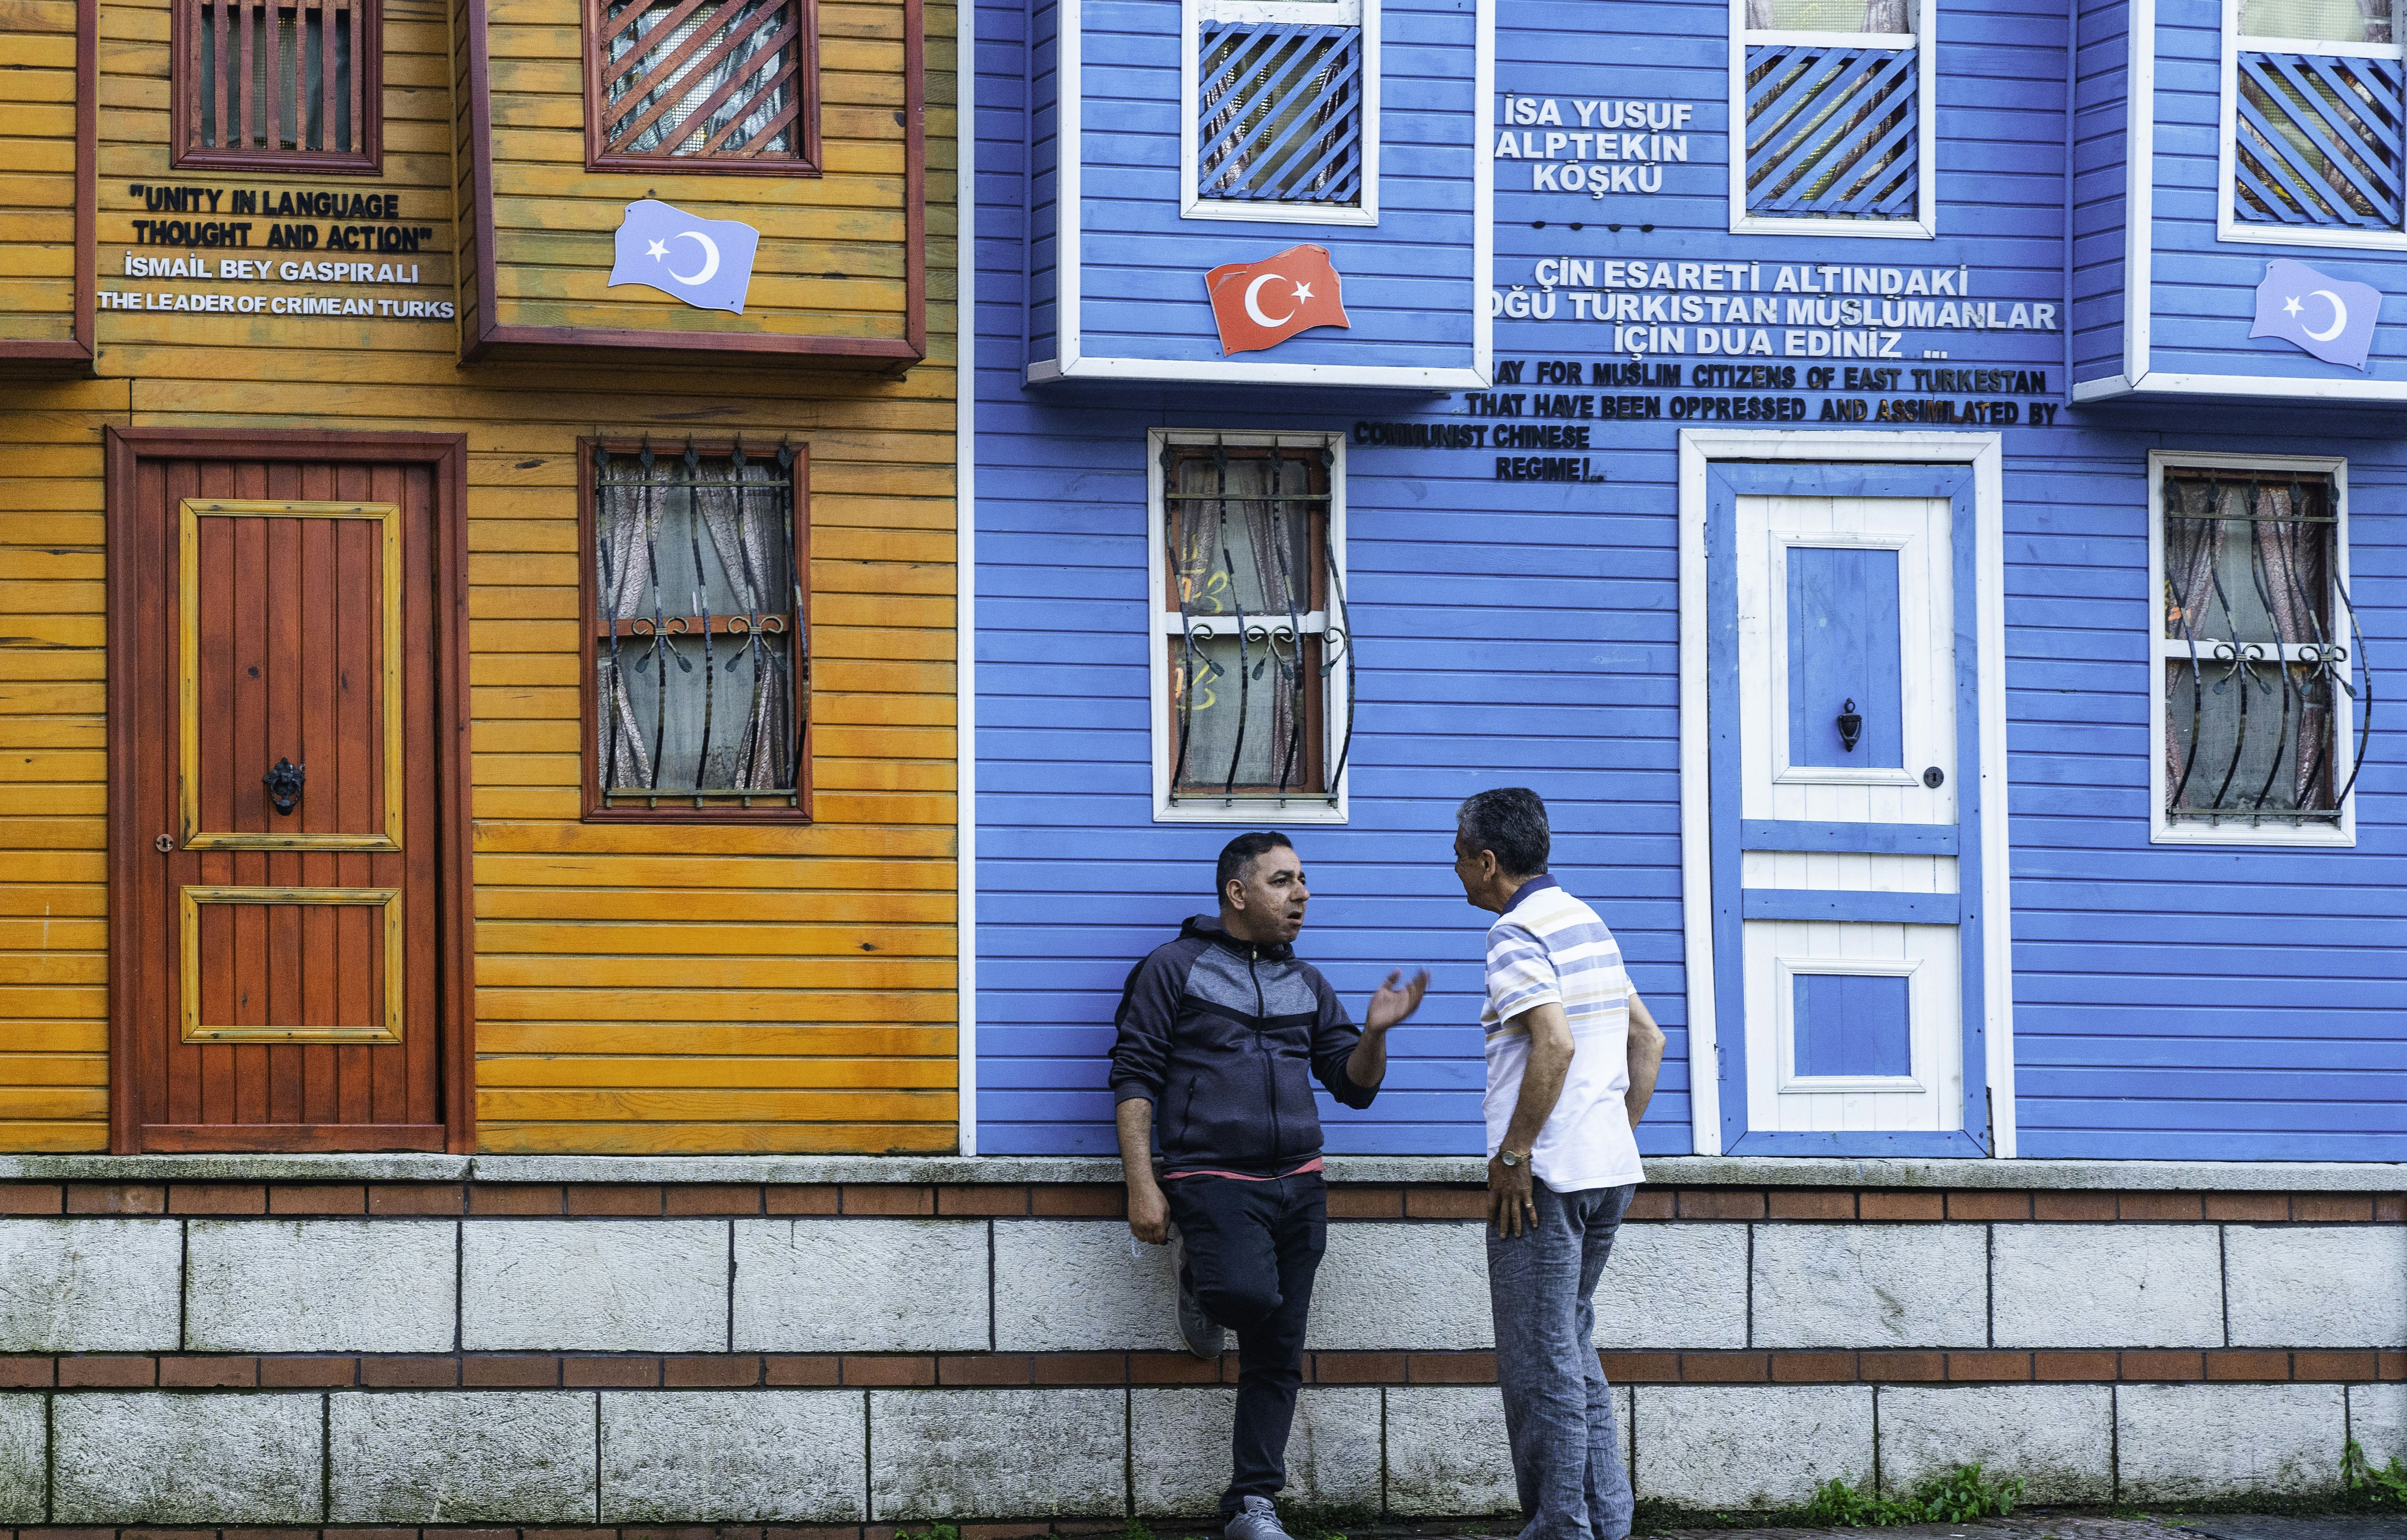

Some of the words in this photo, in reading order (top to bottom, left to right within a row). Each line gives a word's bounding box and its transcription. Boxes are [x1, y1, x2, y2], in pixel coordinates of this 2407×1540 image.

[1505, 94, 1563, 126] İSA
[1572, 100, 1692, 130] YUSUF
[1494, 129, 1687, 162] ALPTEKİN
[1533, 159, 1662, 199] KÖŞKÜ
[131, 184, 223, 212] "UNITY
[232, 190, 256, 213] IN
[263, 191, 399, 218] LANGUAGE
[133, 220, 252, 246] THOUGHT
[268, 224, 318, 248] AND
[328, 225, 433, 251] ACTION"
[125, 251, 212, 279] İSMAİL
[220, 260, 273, 279] BEY
[279, 261, 419, 283] GASPIRALI
[1535, 257, 1594, 293] ÇİN
[1604, 260, 1760, 291] ESARETİ
[1772, 264, 1968, 296] ALTINDAKİ
[97, 291, 142, 310] THE
[146, 293, 235, 312] LEADER
[237, 296, 267, 313] OF
[270, 297, 374, 316] CRIMEAN
[378, 299, 455, 318] TURKS
[1614, 321, 1684, 361] İÇİN
[1697, 327, 1773, 356] DUA
[1785, 325, 1902, 357] EDİNİZ
[1538, 361, 1582, 384] FOR
[1593, 363, 1681, 386] MUSLIM
[1693, 365, 1795, 389] CITIZENS
[1807, 366, 1835, 389] OF
[1845, 367, 1901, 391] EAST
[1912, 368, 2046, 393] TURKESTAN
[1465, 393, 1526, 416] THAT
[1535, 394, 1594, 417] HAVE
[1602, 396, 1660, 418] BEEN
[1670, 397, 1806, 421] OPPRESSED
[1820, 399, 1867, 421] AND
[1876, 399, 2018, 424] ASSIMILATED
[2029, 402, 2058, 425] BY
[1355, 423, 1488, 447] COMMUNIST
[1493, 424, 1590, 449] CHINESE
